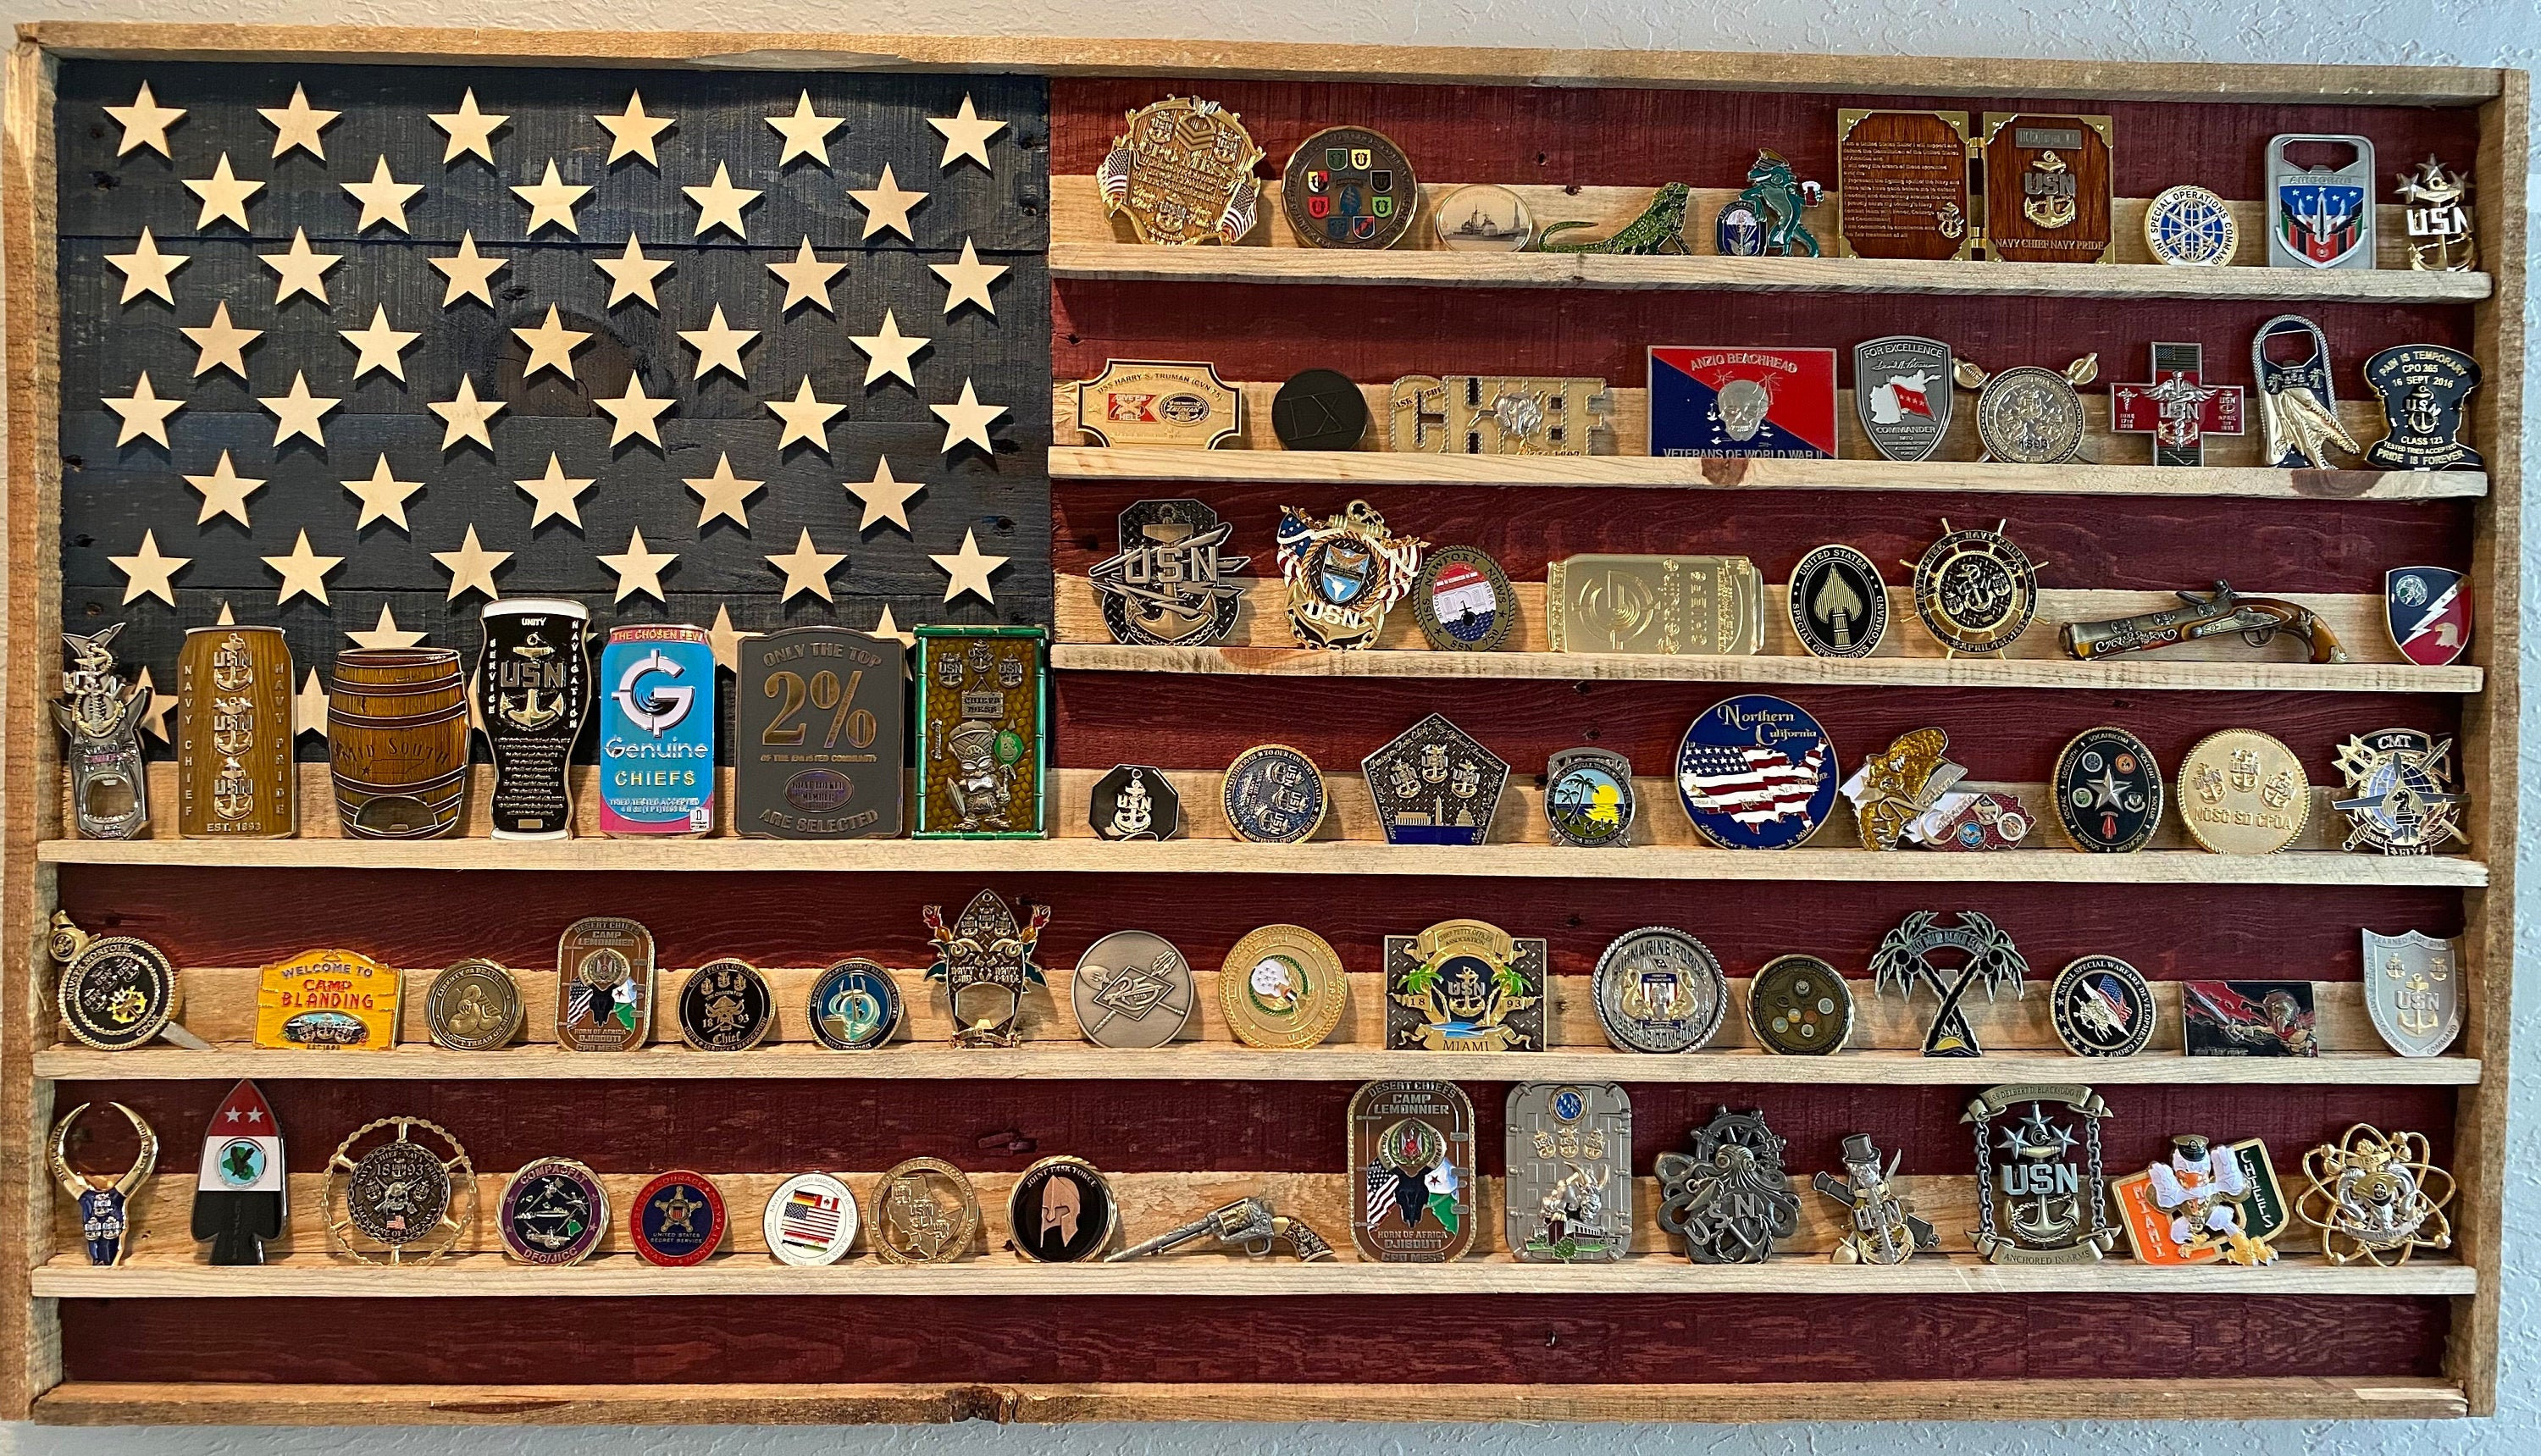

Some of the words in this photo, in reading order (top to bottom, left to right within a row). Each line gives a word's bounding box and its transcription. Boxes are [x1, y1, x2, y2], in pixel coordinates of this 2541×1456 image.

[2024, 172, 2075, 196] USN
[2173, 191, 2228, 219] OPERATIONS
[2151, 198, 2172, 234] SPECIAL
[2406, 208, 2470, 236] USN
[1995, 238, 2020, 249] NAVY
[2021, 239, 2050, 249] CHIEF
[2051, 240, 2075, 250] NAVY
[2075, 240, 2105, 251] PRIDE
[2152, 238, 2174, 261] JOINT
[2212, 222, 2234, 265] COMMAND
[1863, 346, 1884, 359] FOR
[1885, 343, 1944, 358] EXCELLENCE
[1691, 354, 1724, 371] ANZIO
[1727, 352, 1798, 374] BEACHHEAD
[2378, 357, 2400, 377] PAIN
[2400, 352, 2411, 363] IS
[2412, 350, 2467, 377] TEMPORARY
[2402, 363, 2422, 374] CPO
[2422, 364, 2439, 373] 365
[2392, 378, 2403, 387] 16
[2405, 375, 2430, 385] SEPT
[2433, 376, 2454, 389] 2016
[2405, 398, 2442, 417] USN
[1875, 425, 1936, 434] COMMANDER
[2383, 440, 2406, 452] TESTED
[2425, 441, 2457, 455] ACCEPTED
[2400, 435, 2428, 446] CLASS
[1663, 448, 1724, 458] VETERANS
[1725, 449, 1742, 458] OF
[1744, 449, 1786, 458] WORLD
[1788, 450, 1813, 458] WAR
[2376, 447, 2404, 463] PRIDE
[2409, 455, 2419, 465] IS
[2422, 449, 2466, 465] FOREVER
[1124, 546, 1218, 584] USN
[1424, 551, 1480, 589] NEWPORT
[1799, 550, 1830, 576] UNITED
[1833, 549, 1868, 571] STATES
[1916, 575, 1925, 603] NAVY
[1921, 544, 1946, 571] CHIEF
[1965, 531, 1995, 541] NAVY
[1996, 535, 2026, 565] PRIDE
[1485, 567, 1508, 605] NEWS
[1304, 601, 1361, 629] USN
[1421, 598, 1435, 622] USS
[521, 617, 546, 627] UNITY
[1792, 602, 1812, 644] SPECIAL
[1813, 643, 1869, 658] OPERATIONS
[1868, 595, 1885, 645] COMMAND
[612, 631, 633, 641] THE
[635, 630, 678, 640] CHOSEN
[679, 630, 704, 642] FEW
[1449, 640, 1474, 651] SSN
[1482, 628, 1500, 647] 750
[213, 650, 253, 667] USN
[762, 642, 805, 668] ONLY
[810, 641, 844, 658] THE
[850, 646, 884, 669] TOP
[967, 647, 994, 662] USN
[488, 638, 498, 715] SERVICE
[500, 662, 566, 688] USN
[569, 619, 579, 729] NAVIGATION
[938, 662, 963, 674] USN
[998, 662, 1023, 674] USN
[762, 669, 877, 750] 2%
[1717, 704, 1795, 731] Northern
[213, 715, 253, 732] USN
[1755, 722, 1818, 746] California
[2088, 733, 2129, 745] SOCAFRICOM
[2377, 734, 2413, 750] CMT
[340, 744, 375, 767] MID
[388, 737, 451, 766] SOUTH
[604, 734, 710, 760] Genuine
[760, 754, 771, 762] OF
[773, 754, 789, 762] THE
[791, 754, 830, 762] ENLISTED
[831, 754, 877, 762] COMMUNITY
[2061, 748, 2079, 779] SOCSOUTH
[615, 770, 697, 787] CHIEFS
[1283, 764, 1298, 788] USN
[213, 779, 253, 796] USN
[1115, 794, 1152, 810] USN
[1287, 790, 1302, 814] USN
[2060, 794, 2072, 820] SOCPAC
[206, 822, 231, 833] EST.
[235, 822, 262, 833] 1893
[758, 808, 794, 829] ARE
[796, 809, 879, 833] SELECTED
[1270, 811, 1285, 835] USN
[2194, 806, 2232, 822] NOSC
[2234, 809, 2254, 825] SD
[2256, 811, 2294, 831] CPOA
[574, 922, 608, 933] DESERT
[609, 922, 642, 936] CHIEFS
[592, 931, 623, 939] CAMP
[578, 938, 634, 947] LEMONNIER
[1444, 937, 1486, 947] ASSOCIATION
[1613, 939, 1670, 981] SUBMARINE
[1674, 942, 1708, 978] FORCE
[2074, 961, 2105, 975] SPECIAL
[66, 963, 86, 1000] NAVSTA
[81, 944, 133, 965] NORFOLK
[281, 963, 352, 980] WELCOME
[353, 966, 374, 978] TO
[2106, 961, 2141, 988] WARFARE
[302, 978, 352, 993] CAMP
[1448, 980, 1486, 999] USN
[2058, 972, 2077, 995] NAVAL
[280, 992, 374, 1010] BLANDING
[1410, 997, 1426, 1007] 18
[1507, 999, 1521, 1008] 93
[2395, 990, 2439, 1011] USN
[702, 1018, 714, 1028] 18
[738, 1013, 750, 1023] 93
[2135, 986, 2152, 1045] DEVELOPMENT
[136, 1014, 160, 1037] CPOA
[579, 1034, 623, 1043] DJIBOUTI
[712, 1031, 741, 1045] Chief
[1442, 1039, 1491, 1052] MIAMI
[2377, 1019, 2409, 1054] SOUTHERN
[2427, 1023, 2457, 1055] COMMAND
[575, 1044, 595, 1052] CPO
[596, 1044, 623, 1052] MESS
[2108, 1044, 2135, 1057] GROUP
[1368, 1080, 1414, 1098] DESERT
[1414, 1080, 1459, 1099] CHIEFS
[1392, 1093, 1431, 1104] CAMP
[1374, 1103, 1450, 1116] LEMONNIER
[377, 1164, 390, 1176] 18
[407, 1164, 424, 1176] 93
[519, 1164, 589, 1185] COMPACFLT
[1027, 1167, 1048, 1188] JOINT
[1049, 1165, 1071, 1174] TASK
[1071, 1166, 1099, 1187] FORCE
[2001, 1162, 2079, 1196] USN
[2240, 1149, 2274, 1229] CHIEFS
[1684, 1193, 1756, 1246] USN
[2133, 1184, 2167, 1259] MIAMI
[1384, 1238, 1442, 1250] DJIBOUTI
[1415, 1231, 1448, 1239] AFRICA
[523, 1247, 579, 1265] DFC/JICC
[1381, 1252, 1409, 1263] CPO
[1410, 1252, 1446, 1263] MESS
